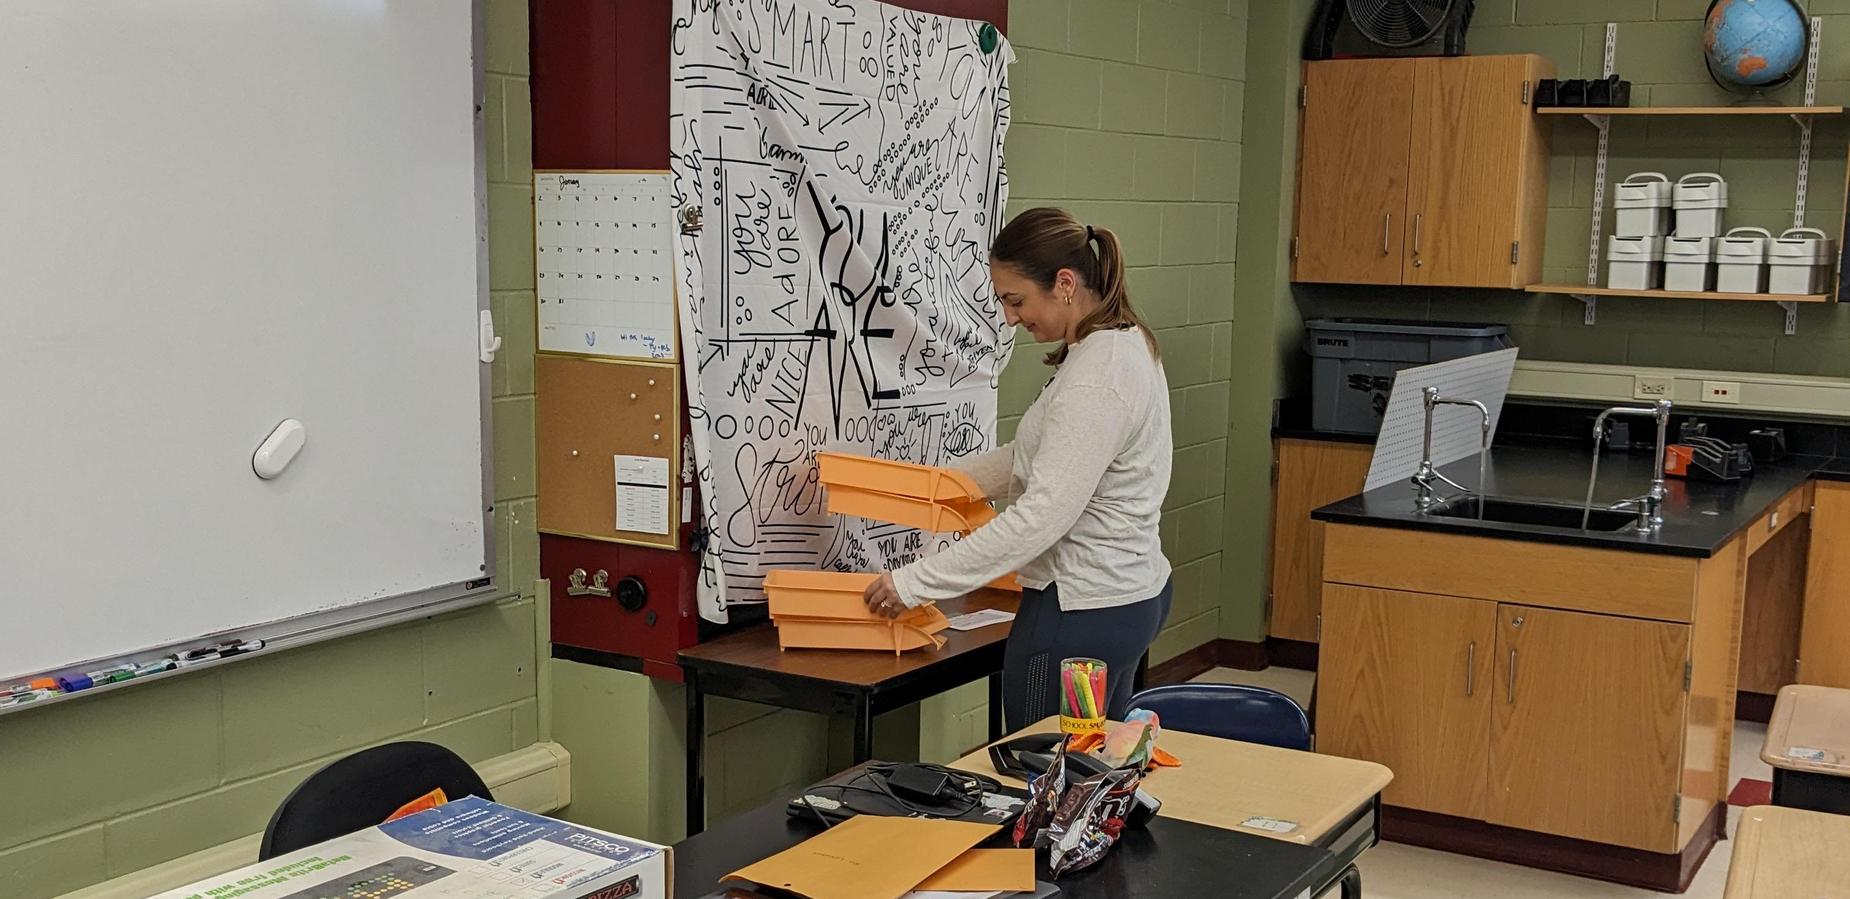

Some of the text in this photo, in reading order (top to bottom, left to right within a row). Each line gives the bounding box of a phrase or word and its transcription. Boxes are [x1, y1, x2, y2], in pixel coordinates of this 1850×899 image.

[886, 15, 898, 102] VALUED
[900, 157, 933, 200] UNIQUE
[1316, 338, 1349, 347] BRUTE
[764, 340, 808, 421] NICE
[803, 421, 828, 450] YOU
[878, 531, 923, 559] YOU ARE
[564, 833, 630, 853] PITSCO
